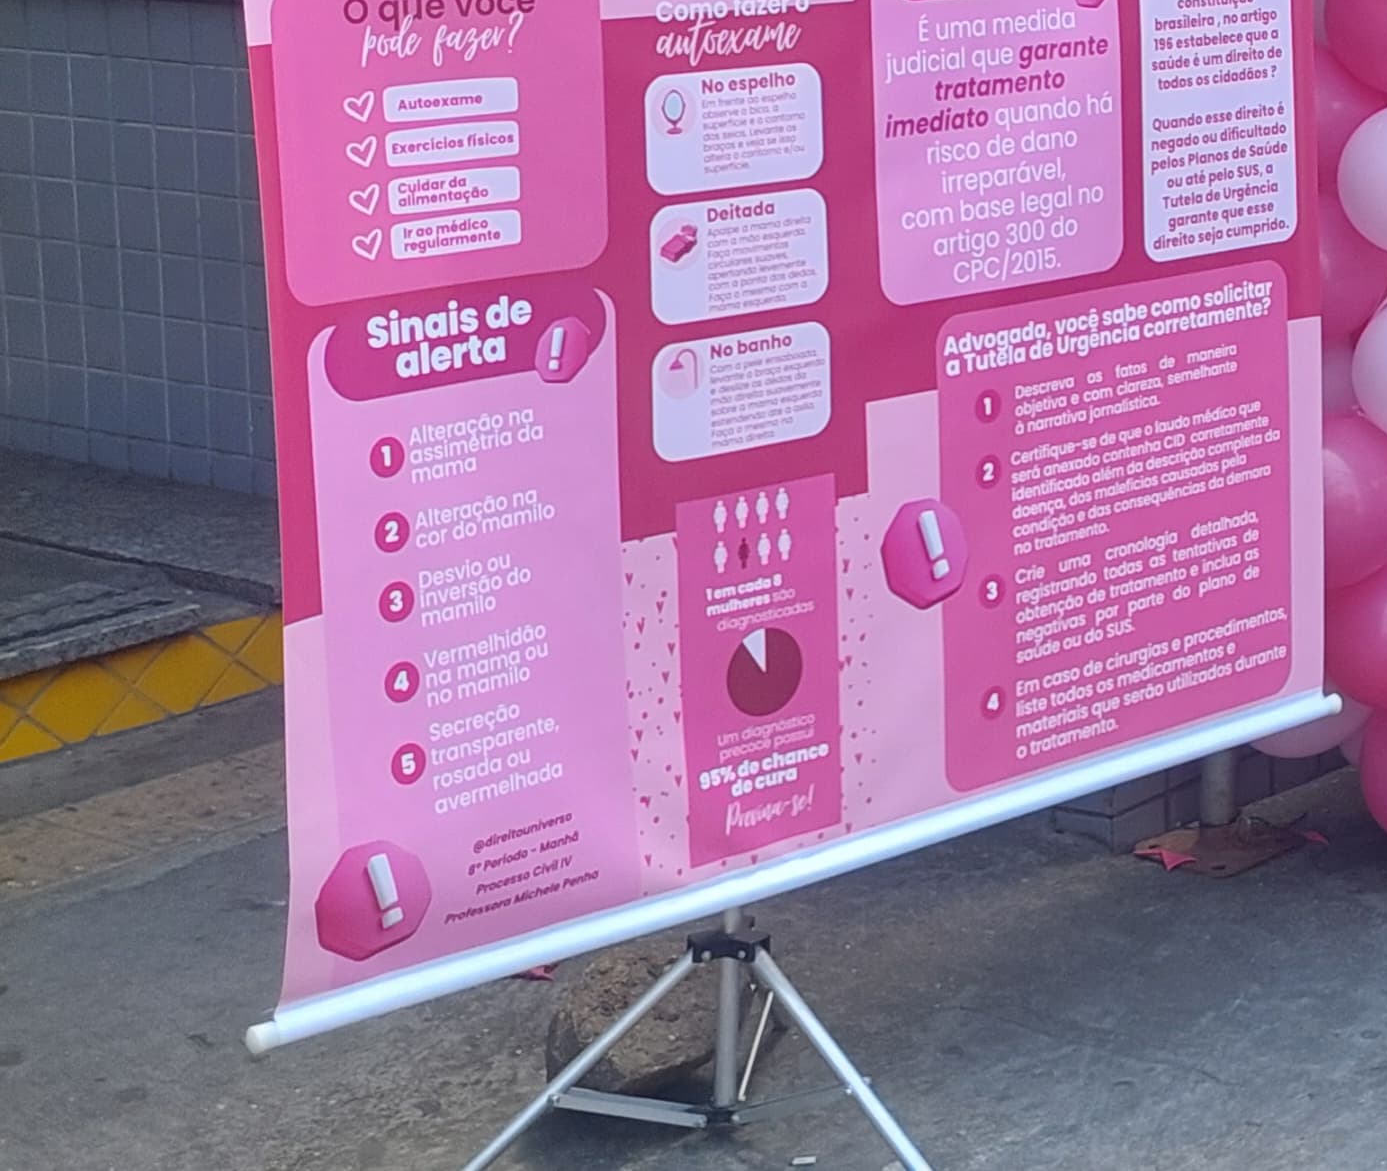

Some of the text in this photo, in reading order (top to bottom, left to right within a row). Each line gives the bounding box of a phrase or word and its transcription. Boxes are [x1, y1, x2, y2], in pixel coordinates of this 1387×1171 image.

[655, 0, 728, 22] Como
[918, 8, 1076, 42] É uma medida
[361, 12, 524, 68] pode fazer?
[656, 20, 802, 66] autoexame
[885, 35, 1109, 83] judicial que garante
[398, 95, 483, 111] Autoexame
[701, 72, 795, 95] No espelho
[935, 69, 1065, 101] tratamento
[885, 91, 1112, 138] imediato quando há
[392, 133, 514, 155] Exercícios físicos
[927, 129, 1077, 165] risco de dano
[398, 176, 467, 194] Cuidar da
[941, 157, 1067, 195] irreparável,
[398, 187, 489, 207] alimentação
[706, 201, 775, 222] Deitada
[901, 184, 1103, 230] com base legal no
[403, 219, 488, 239] Ir ao médico
[404, 230, 501, 253] regularmente
[933, 215, 1078, 258] artigo 300 do
[953, 247, 1062, 283] CPC/2015.
[366, 295, 532, 349] Sinais de
[395, 335, 506, 379] alerta
[710, 334, 792, 360] No banho
[409, 408, 534, 447] Alteração na
[519, 424, 544, 442] da
[411, 456, 477, 484] mama
[415, 490, 537, 529] Alteração na
[416, 502, 555, 549] cor do mamilo
[389, 553, 511, 612] 3 Desvio ou
[419, 567, 531, 609] inversão do
[421, 594, 496, 627] mamilo
[424, 625, 547, 668] Vermelhidão
[425, 643, 549, 690] na mama ou
[426, 665, 531, 708] no mamilo
[429, 703, 520, 742] Secreção
[431, 717, 561, 767] transparente,
[433, 747, 531, 791] rosada ou
[699, 743, 829, 790] 95% de chance
[731, 767, 798, 797] de cura
[435, 761, 563, 814] avermelhada
[476, 855, 572, 895] Processo Civil IV
[444, 869, 599, 925] Professora Michele Penha
